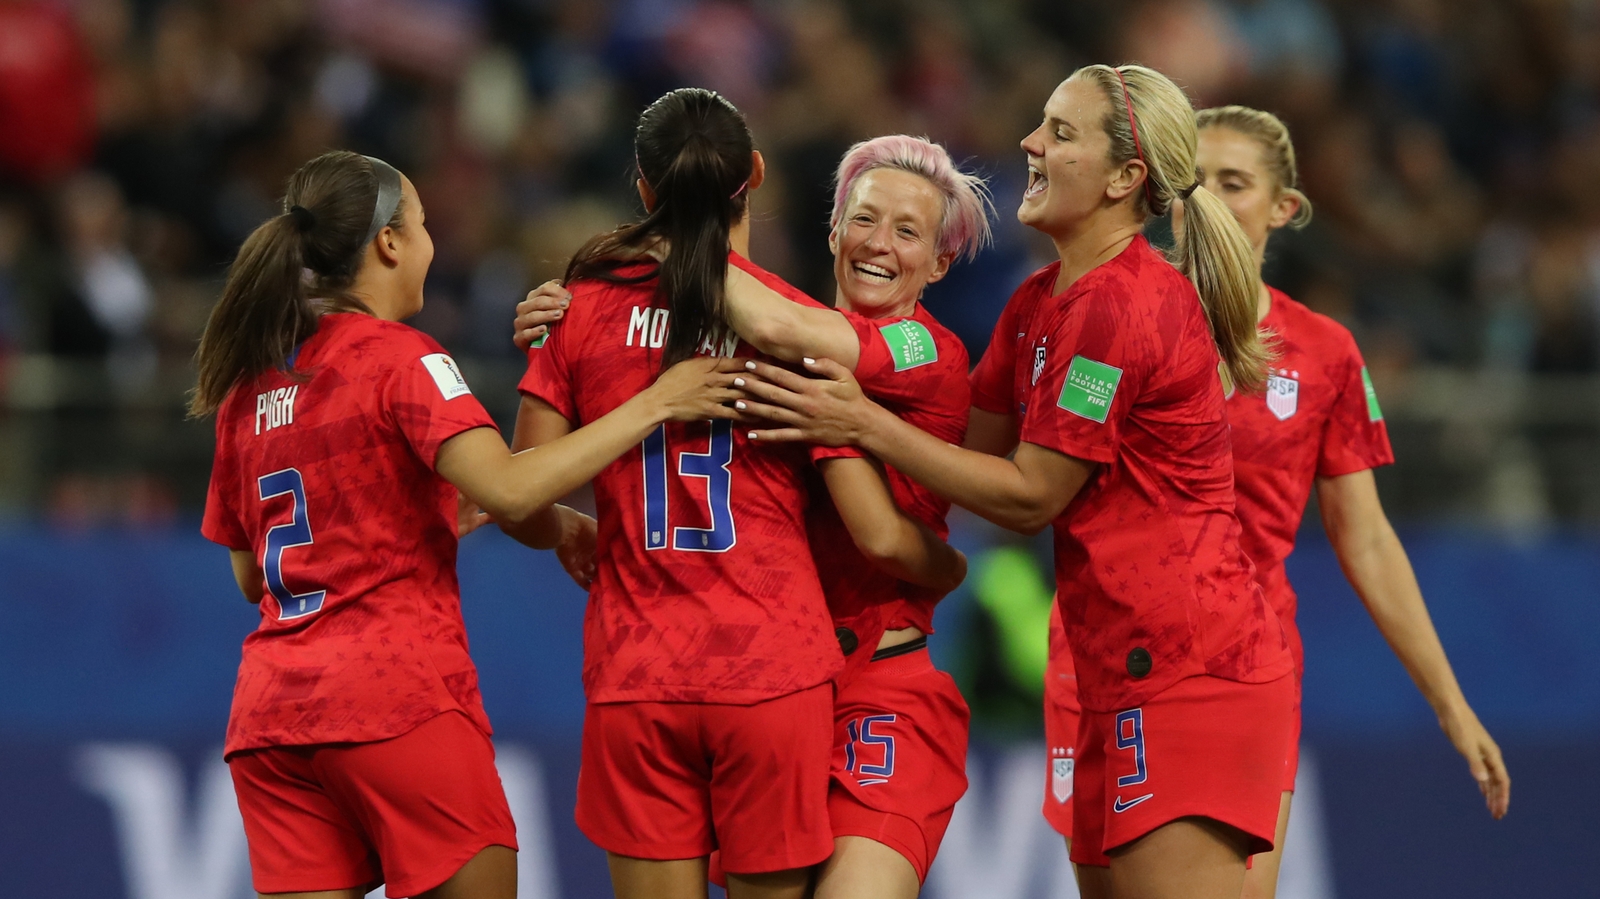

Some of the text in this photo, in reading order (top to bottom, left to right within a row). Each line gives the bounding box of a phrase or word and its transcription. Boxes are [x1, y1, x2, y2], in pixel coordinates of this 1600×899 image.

[626, 305, 740, 359] MOAN
[902, 345, 912, 364] FIFA
[1070, 375, 1110, 395] FOOTBALL
[1072, 370, 1113, 389] LIVING
[1087, 395, 1107, 407] FIFA
[255, 384, 299, 436] PUGH
[642, 419, 737, 552] 13
[258, 467, 326, 620] 2
[845, 714, 897, 778] 15
[1115, 708, 1147, 787] 9
